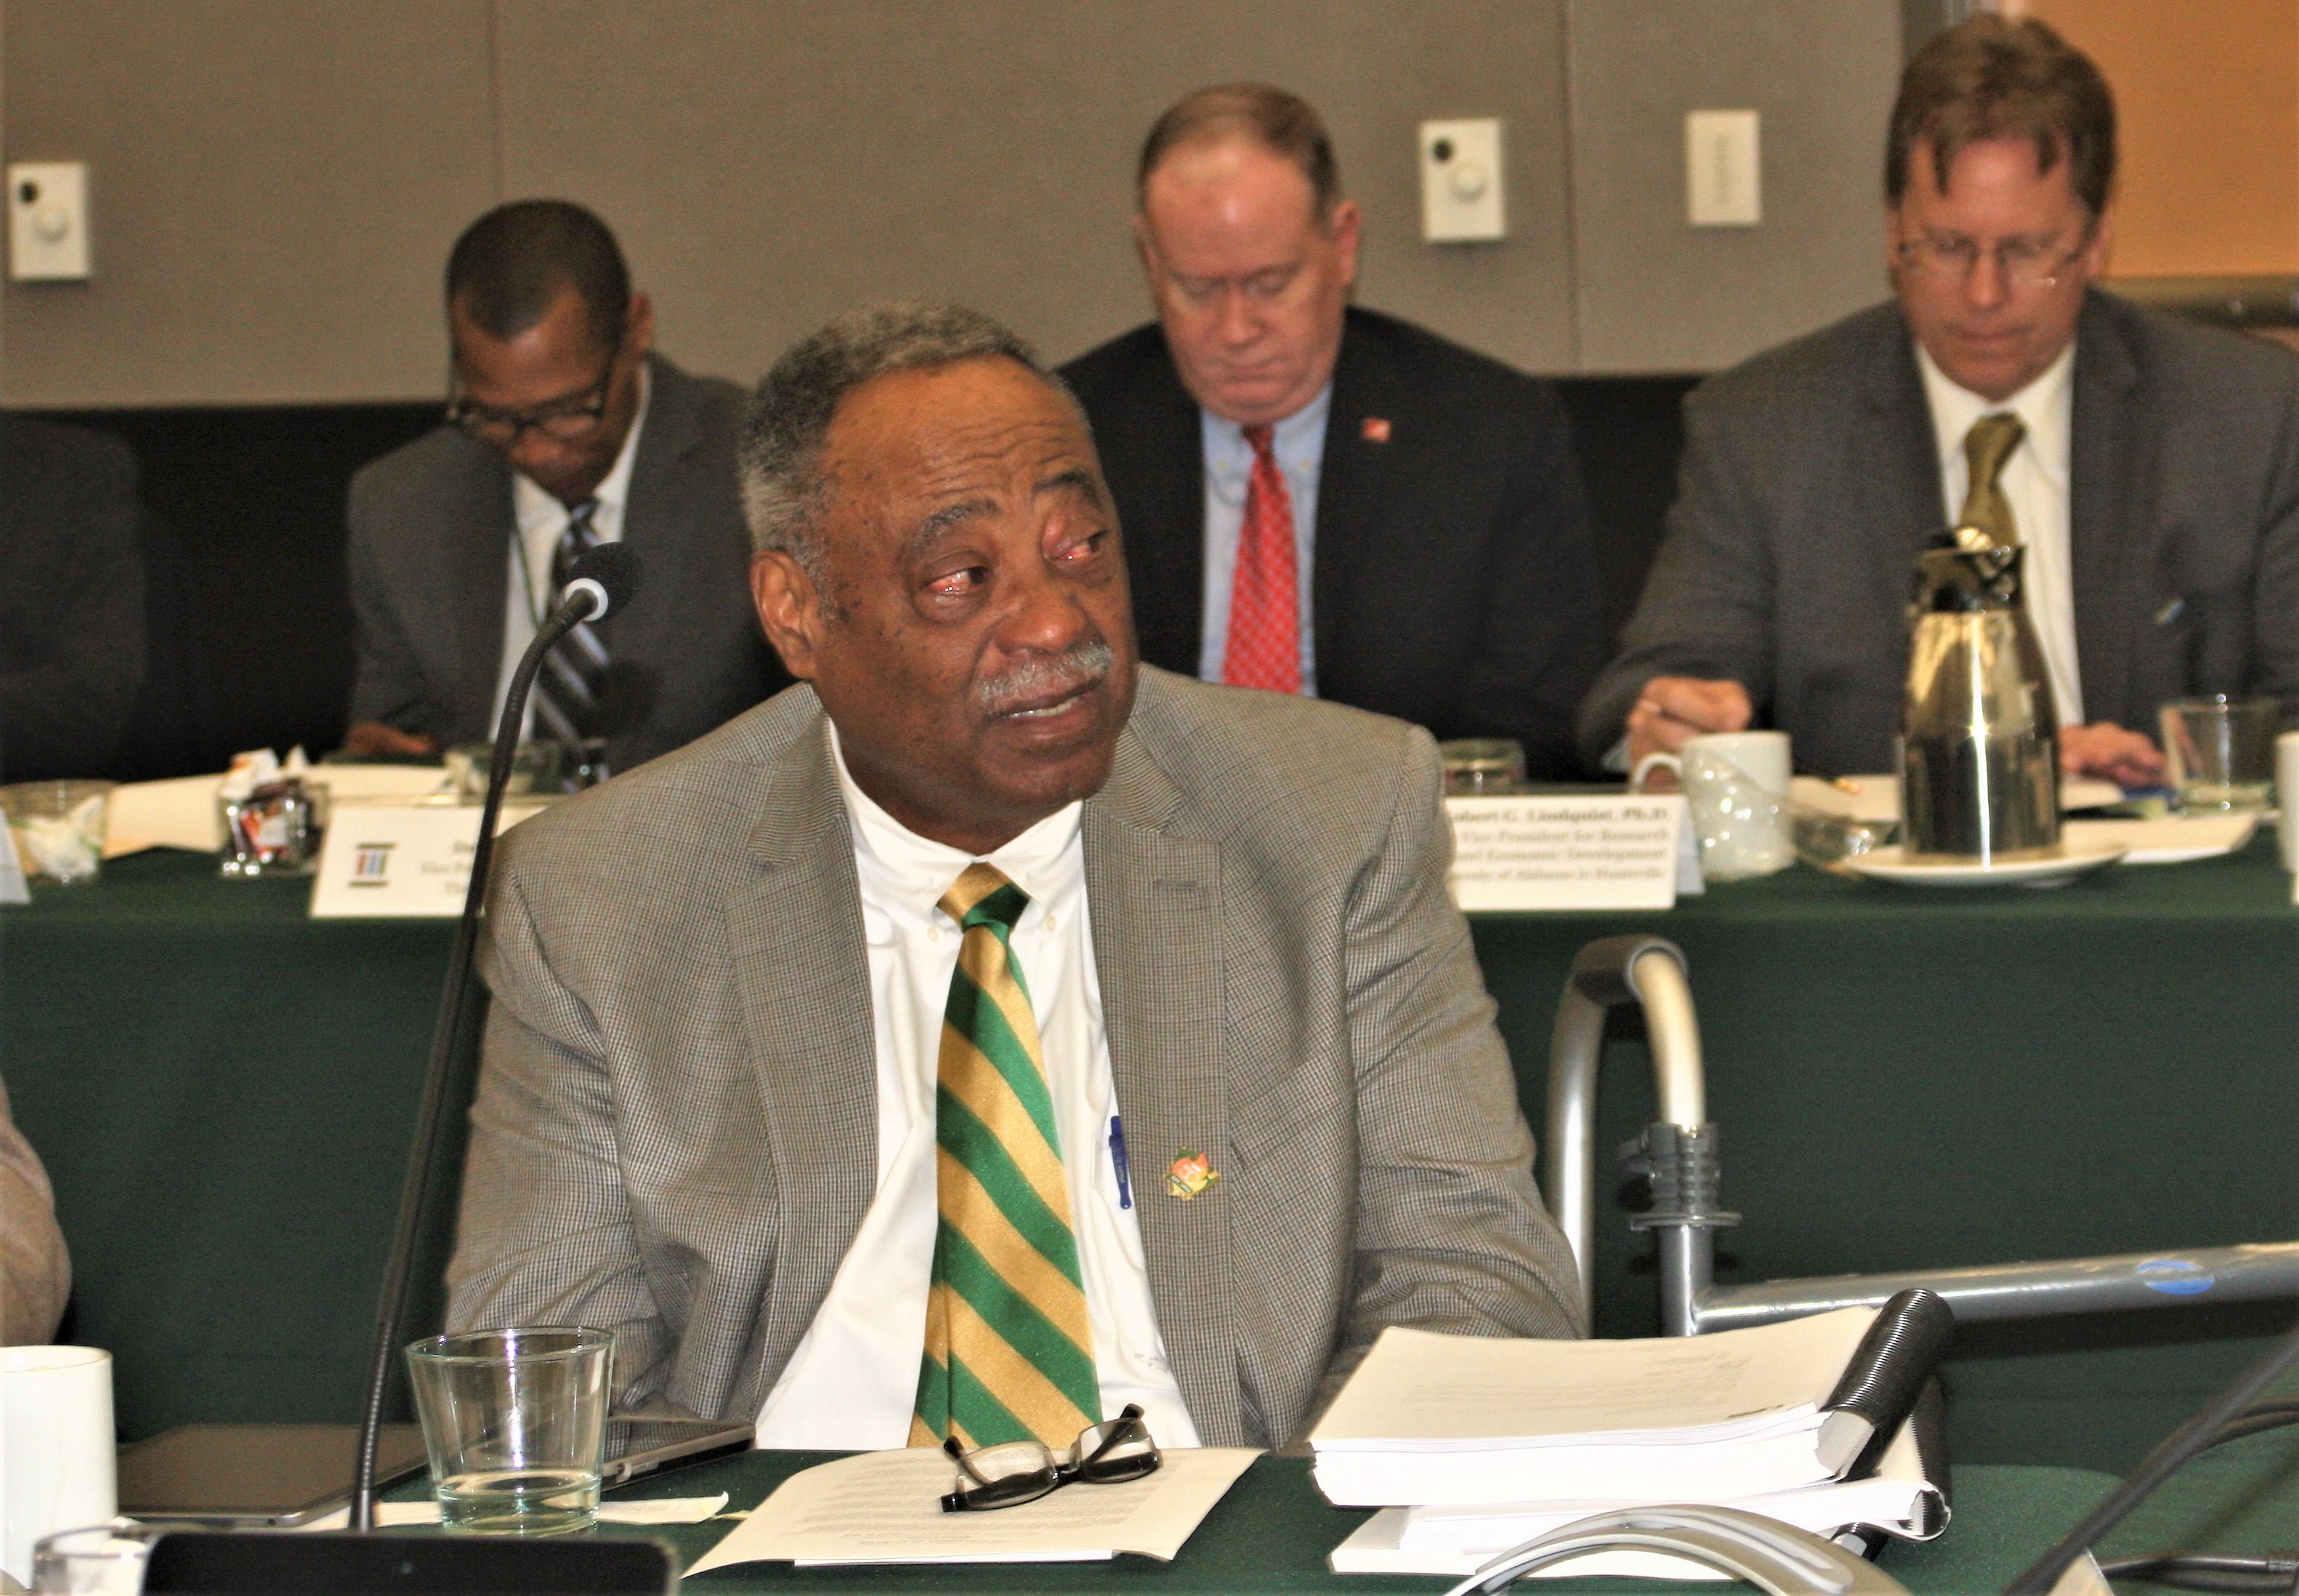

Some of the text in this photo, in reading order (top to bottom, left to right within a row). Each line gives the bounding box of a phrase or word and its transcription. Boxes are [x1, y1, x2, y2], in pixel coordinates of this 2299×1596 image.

[1453, 808, 1498, 822] obert
[1498, 830, 1567, 843] President
[1600, 827, 1670, 841] Research
[1567, 846, 1668, 863] Development
